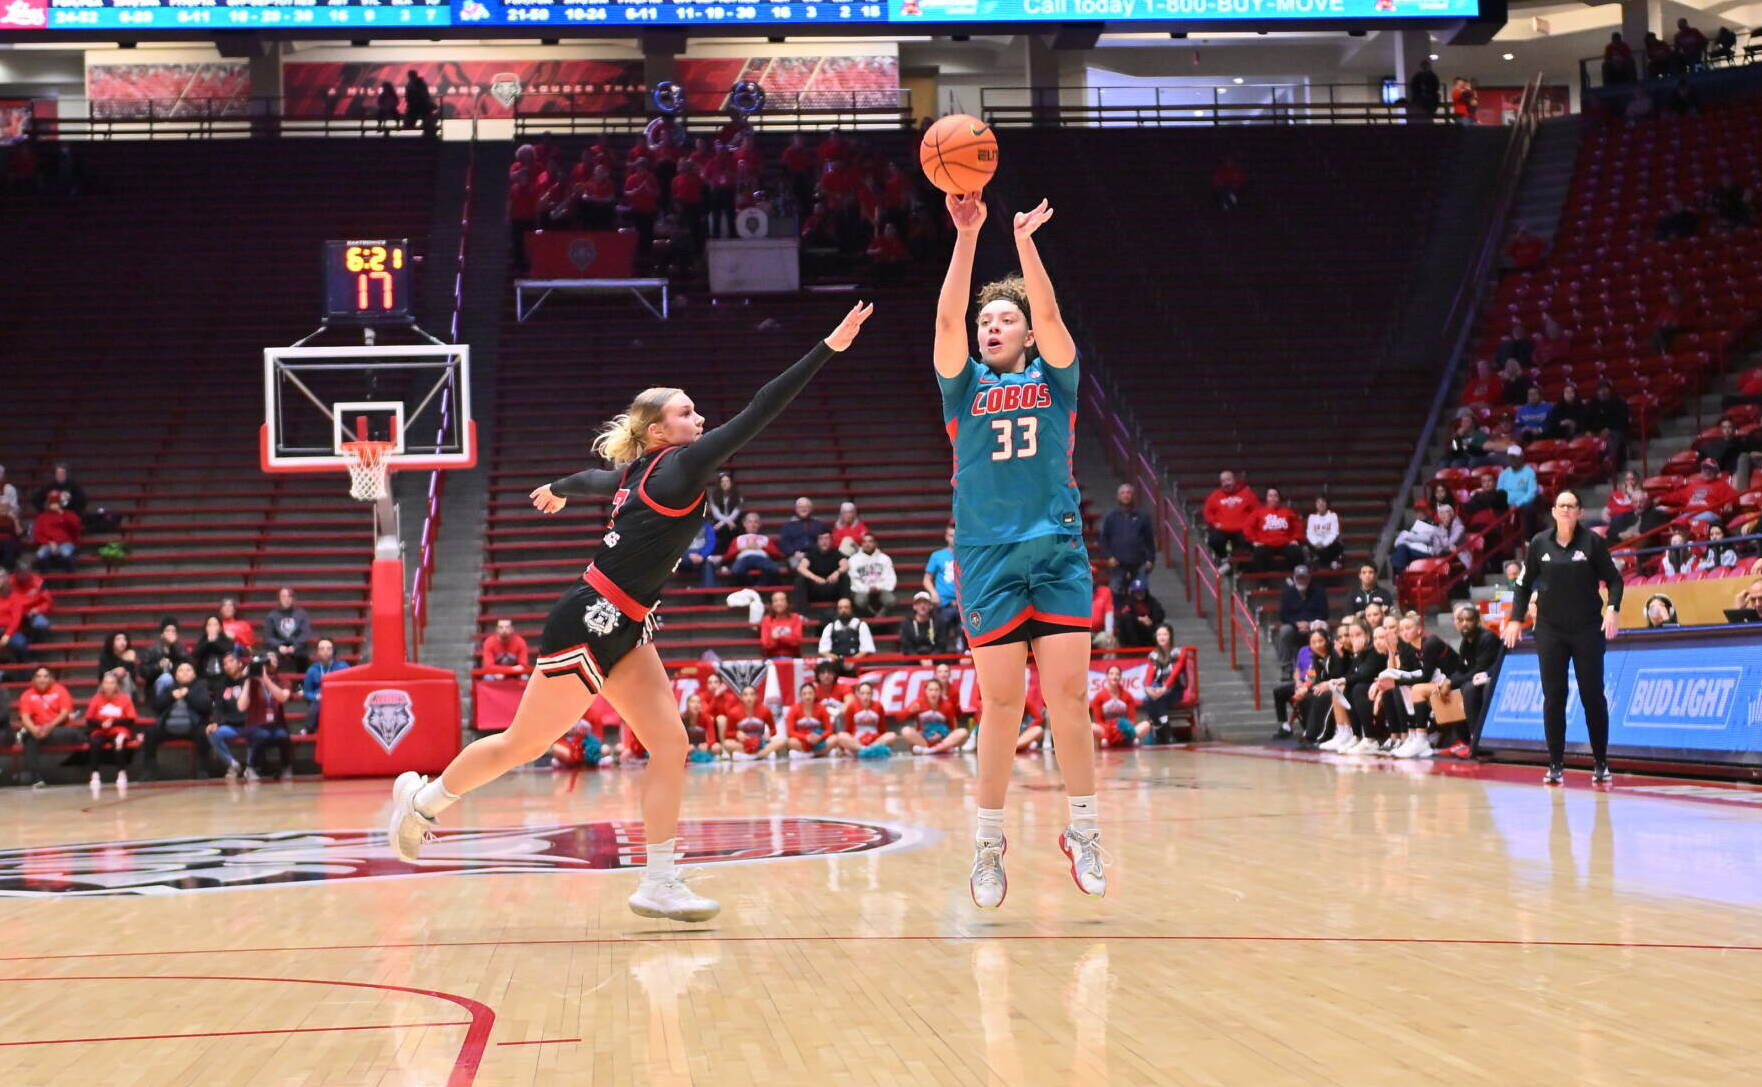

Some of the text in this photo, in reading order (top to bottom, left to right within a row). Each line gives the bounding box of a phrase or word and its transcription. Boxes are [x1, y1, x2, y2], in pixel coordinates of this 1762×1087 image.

[1023, 0, 1345, 17] Call today 1-800-BUY-MOVE
[346, 246, 403, 272] 6:21
[358, 271, 393, 310] 17
[971, 383, 1052, 416] LOBOS
[990, 416, 1039, 462] 33
[1500, 680, 1536, 713] BUD
[1629, 678, 1736, 718] BUD LIGHT
